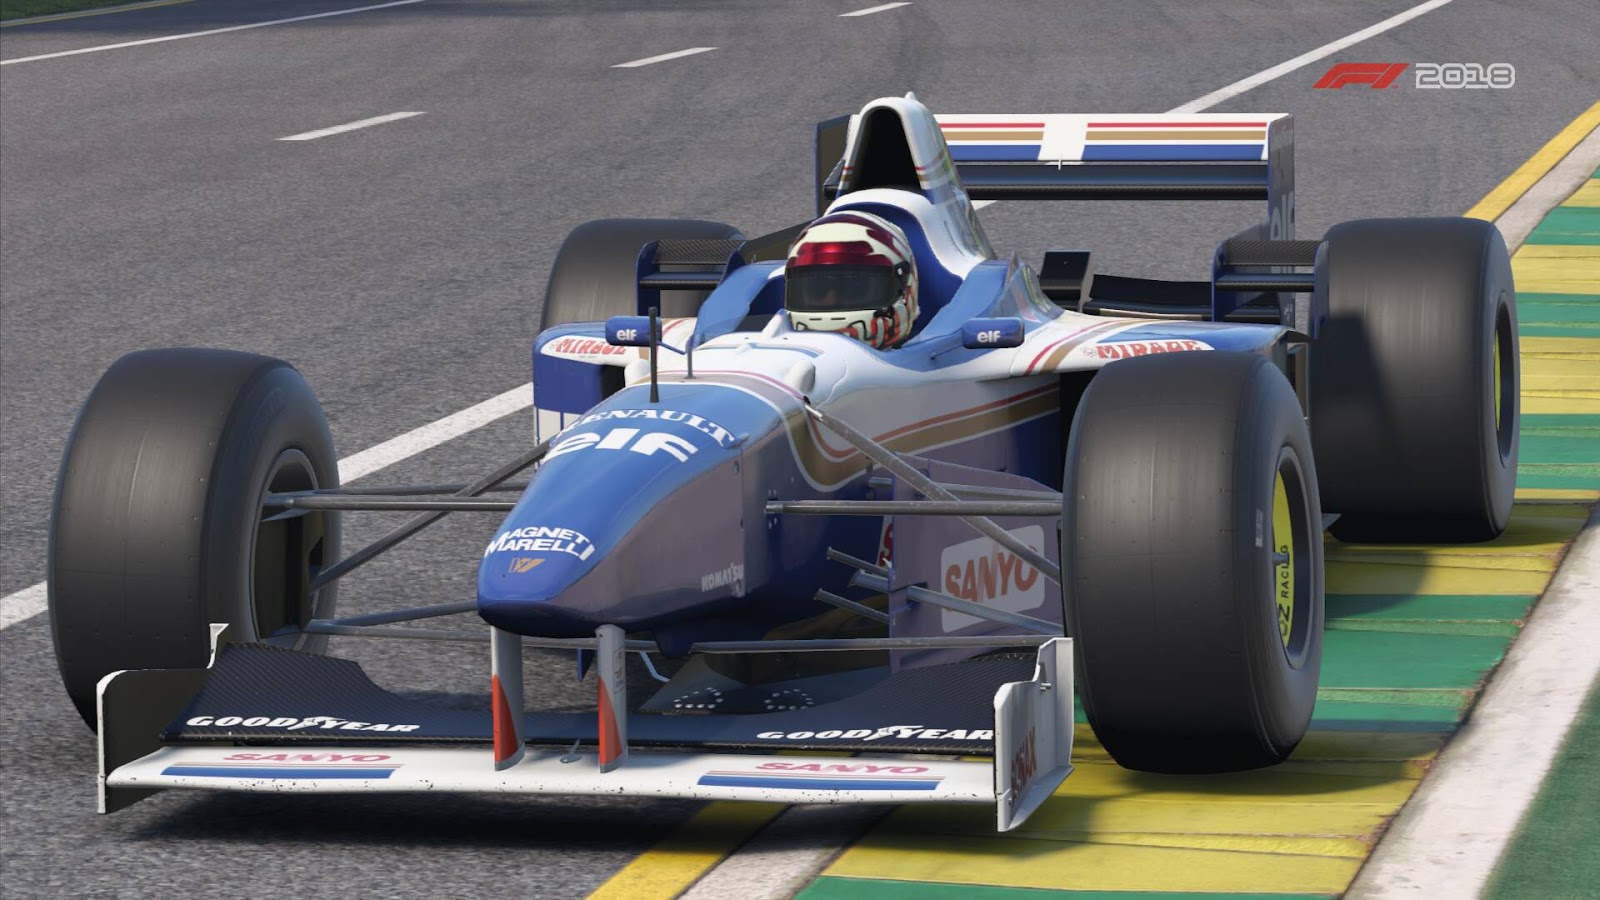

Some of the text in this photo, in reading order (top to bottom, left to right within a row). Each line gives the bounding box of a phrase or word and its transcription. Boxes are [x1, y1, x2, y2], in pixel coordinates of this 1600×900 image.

[616, 329, 637, 341] elf
[976, 331, 1001, 343] elf
[541, 428, 699, 464] elf
[701, 562, 744, 593] KOMATSU
[945, 545, 1039, 611] SANYO
[1279, 544, 1290, 599] RACIG
[223, 753, 391, 762] SANYO
[755, 762, 930, 774] SANYO
